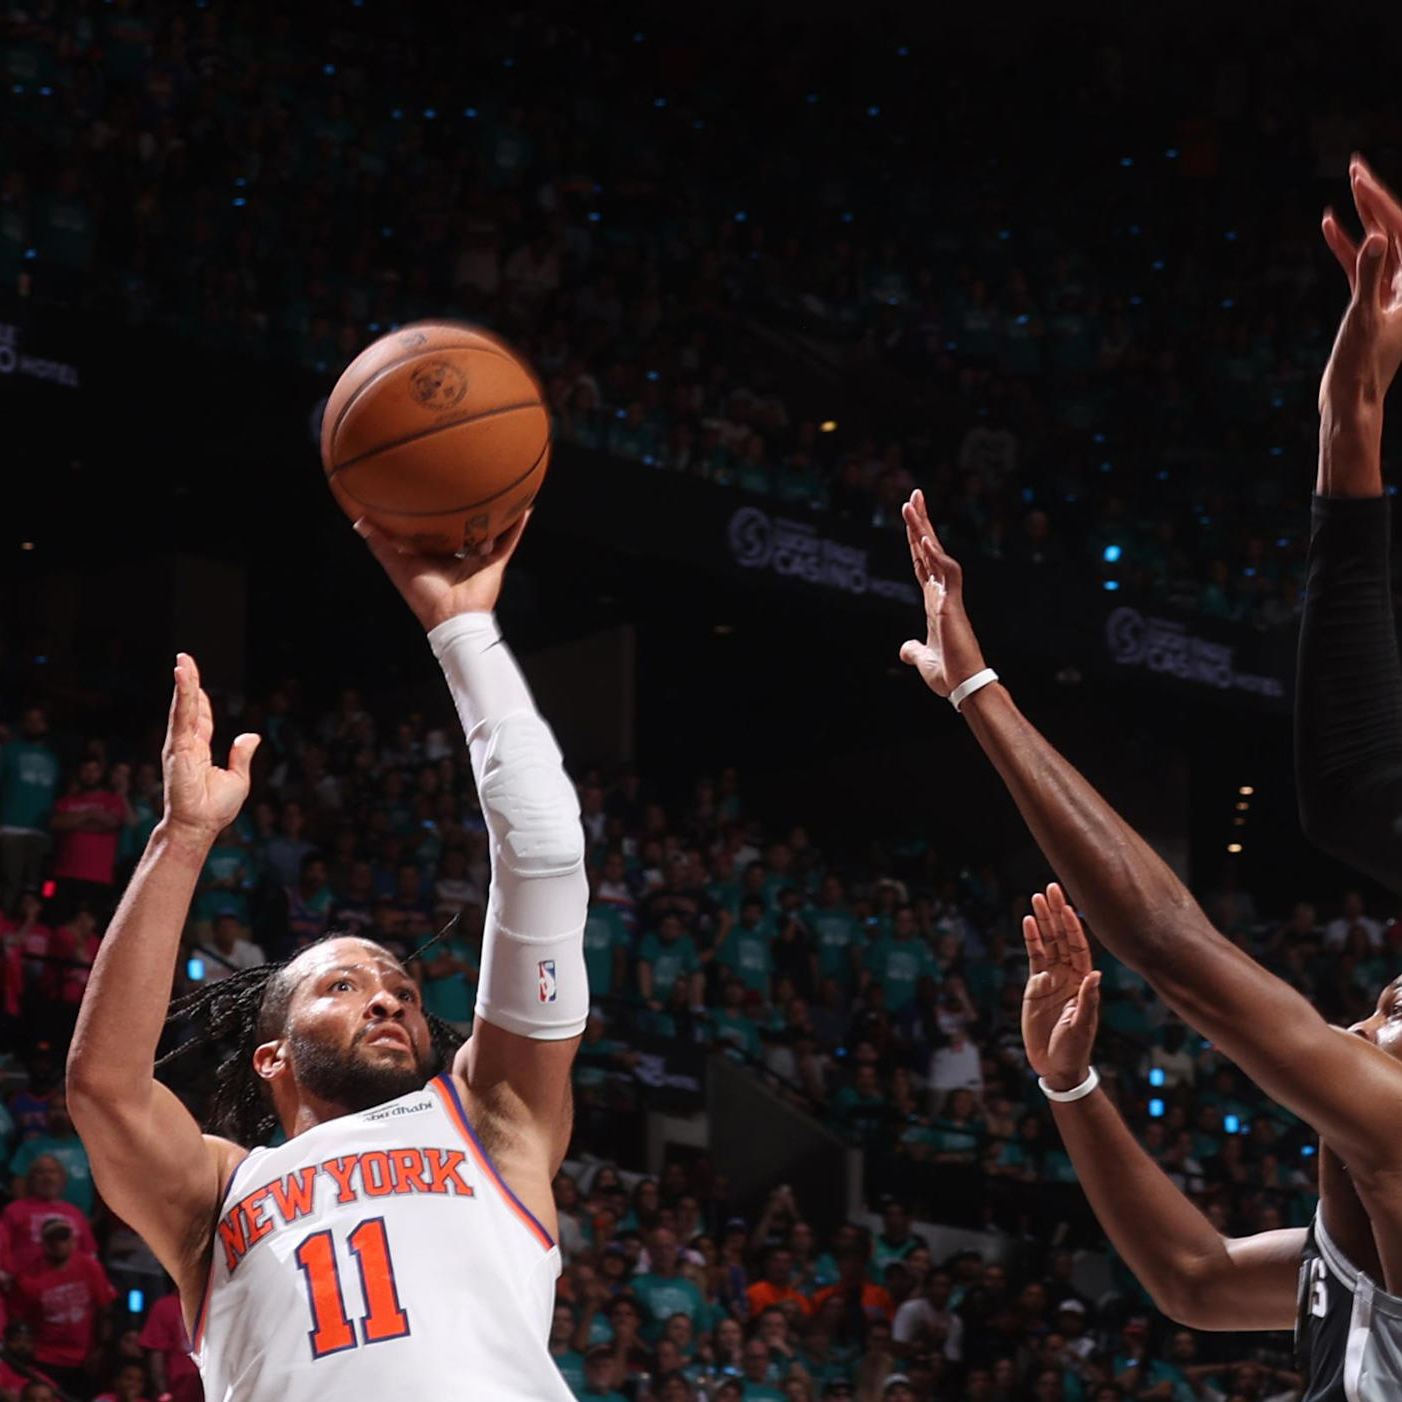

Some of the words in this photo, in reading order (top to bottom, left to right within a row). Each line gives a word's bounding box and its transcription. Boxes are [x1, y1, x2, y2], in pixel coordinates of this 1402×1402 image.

[218, 1166, 318, 1275] NEW
[318, 1147, 476, 1208] YORK
[294, 1216, 411, 1361] 11
